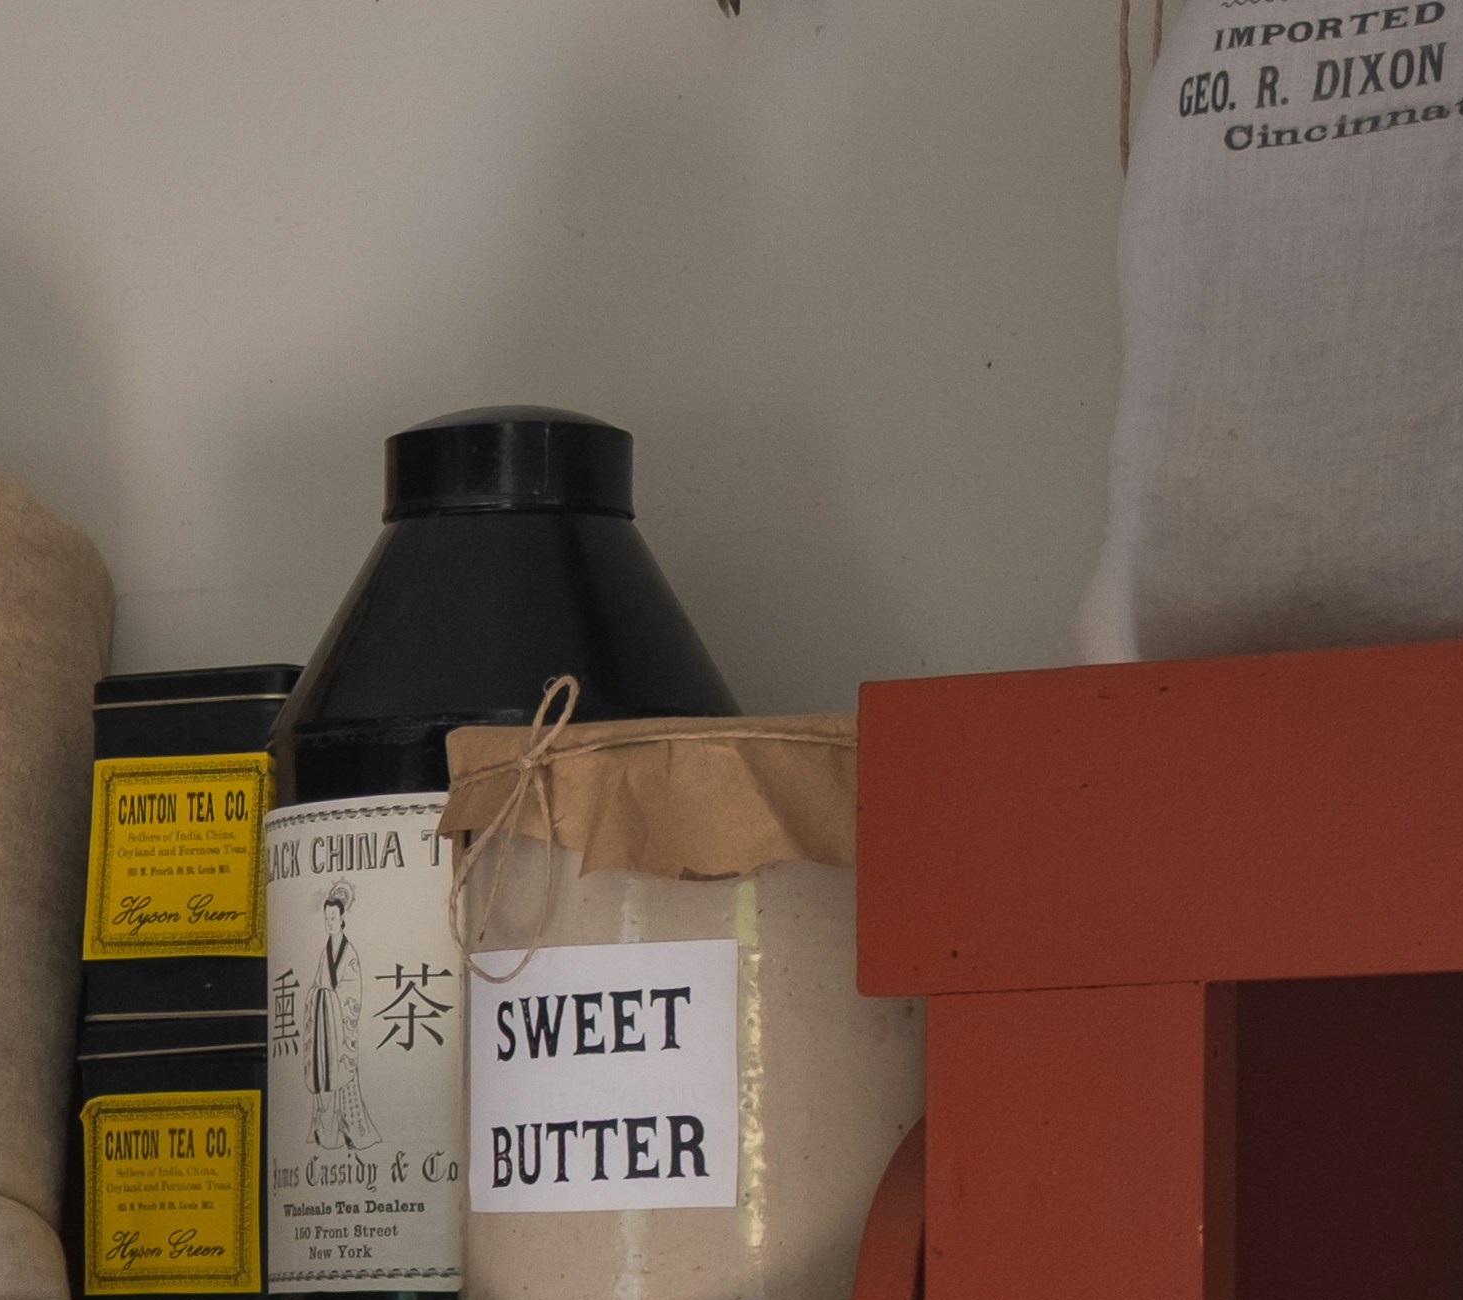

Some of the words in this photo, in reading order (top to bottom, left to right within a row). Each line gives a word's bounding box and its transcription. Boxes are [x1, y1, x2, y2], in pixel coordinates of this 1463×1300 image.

[1214, 1, 1446, 52] IMPORTED
[1179, 70, 1236, 117] GEO.
[1255, 65, 1288, 109] R.
[1311, 41, 1448, 103] DIXON
[118, 793, 176, 825] CANTON
[187, 792, 214, 822] TEA
[225, 790, 248, 821] CO.
[309, 831, 405, 874] CHINA
[112, 896, 181, 936] Hyson
[187, 894, 246, 924] Green
[373, 963, 454, 1051] 茶
[497, 986, 691, 1061] SWEET
[105, 1130, 159, 1160] CANTON
[168, 1128, 195, 1158] TEA
[206, 1127, 231, 1158] CO.
[491, 1115, 710, 1189] BUTTER
[305, 1153, 378, 1192] Cassidy
[391, 1150, 409, 1183] &
[335, 1202, 360, 1215] Tea
[365, 1200, 425, 1213] Dealers
[105, 1231, 163, 1270] Hyson
[168, 1229, 225, 1259] Green
[294, 1227, 311, 1240] 150
[315, 1226, 349, 1240] Front
[354, 1224, 399, 1238] Street
[309, 1246, 331, 1260] New
[338, 1245, 373, 1259] York
